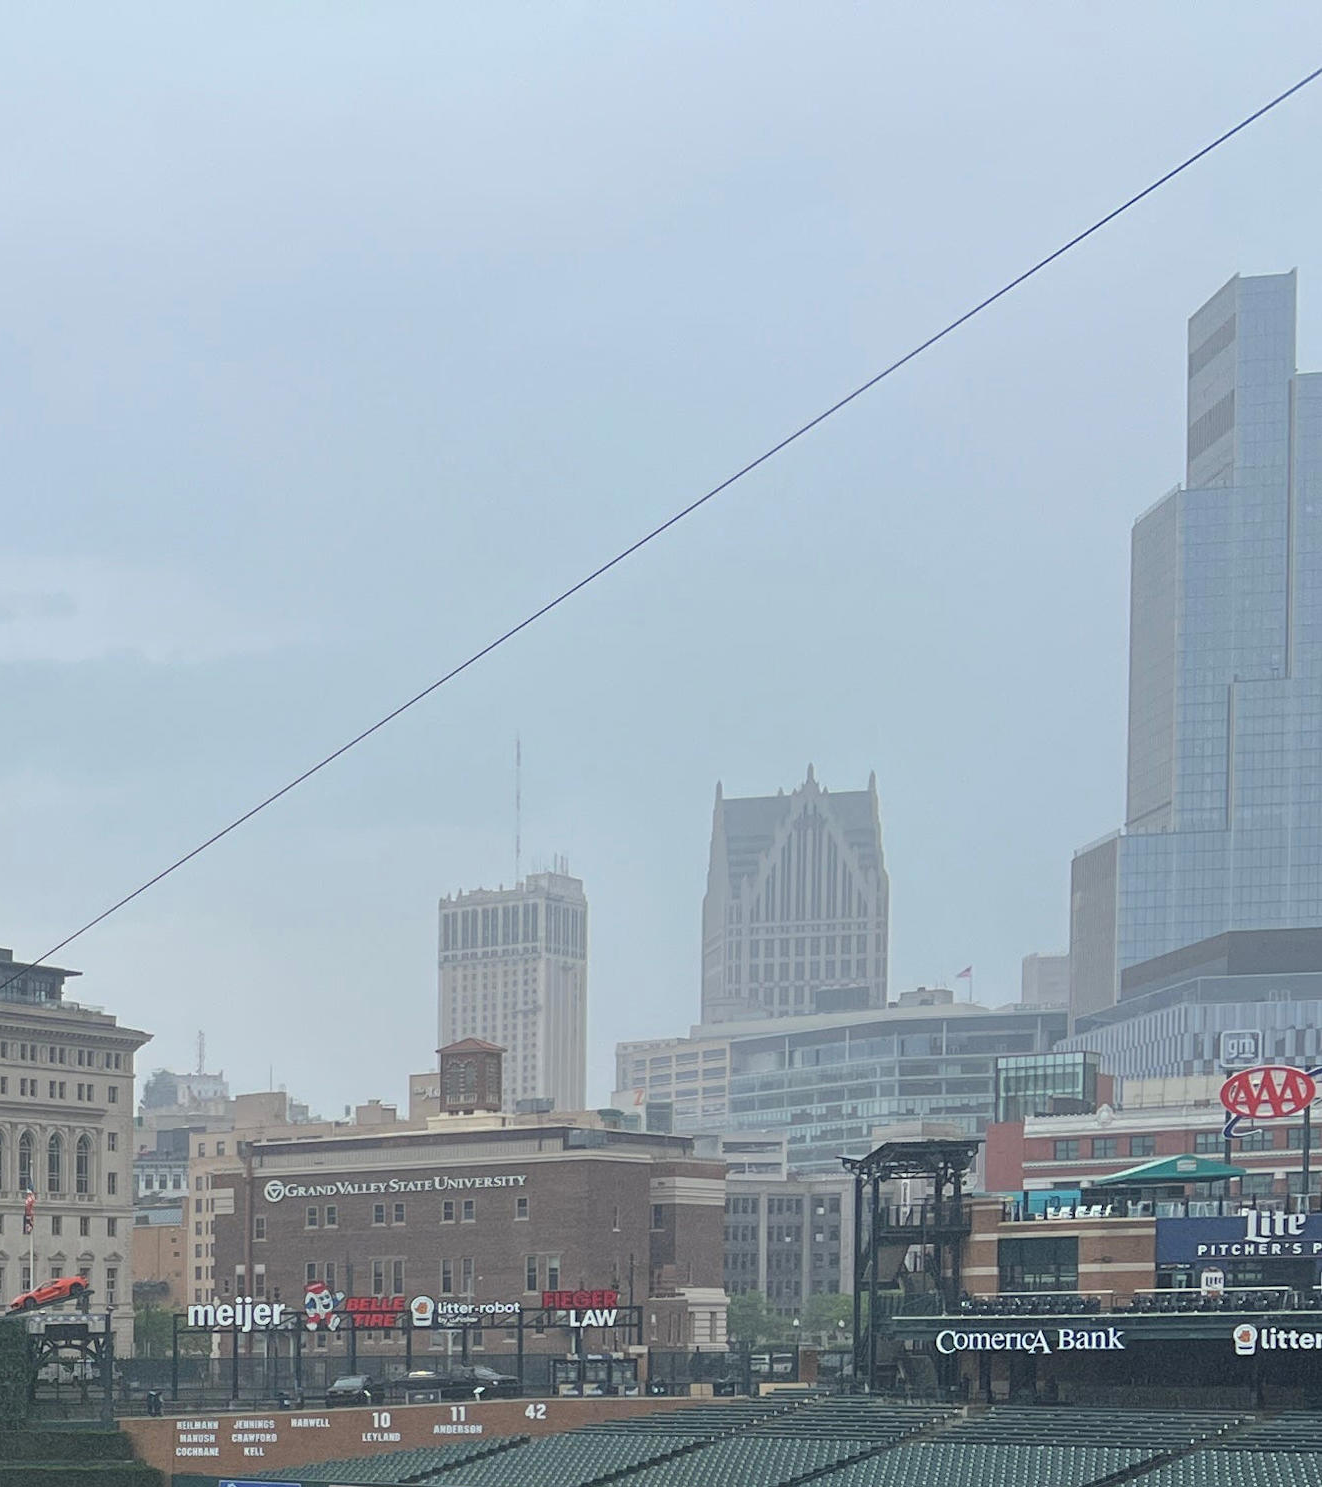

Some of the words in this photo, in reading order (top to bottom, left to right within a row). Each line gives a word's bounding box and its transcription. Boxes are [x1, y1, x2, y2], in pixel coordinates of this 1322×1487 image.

[1228, 1066, 1312, 1117] AAA
[285, 1183, 337, 1197] GRAND
[336, 1181, 387, 1195] VALLEY
[389, 1179, 433, 1193] STATE
[434, 1175, 527, 1190] UNIVERSITY
[1244, 1208, 1307, 1243] Lite
[1197, 1242, 1302, 1257] PITCHER'S
[345, 1296, 406, 1311] BELLE
[541, 1290, 620, 1309] FIEGER
[187, 1296, 286, 1333] meijer
[437, 1301, 521, 1314] litter-robot
[352, 1314, 396, 1327] TIRE
[569, 1309, 618, 1328] LAW
[1057, 1327, 1125, 1351] Bank
[450, 1406, 466, 1421] 11
[525, 1404, 547, 1419] 42
[372, 1412, 390, 1428] 10
[433, 1424, 483, 1433] ANDERSON
[361, 1433, 401, 1442] LEYLAND
[175, 1447, 220, 1457] COCHRANE
[243, 1447, 265, 1456] KELL
